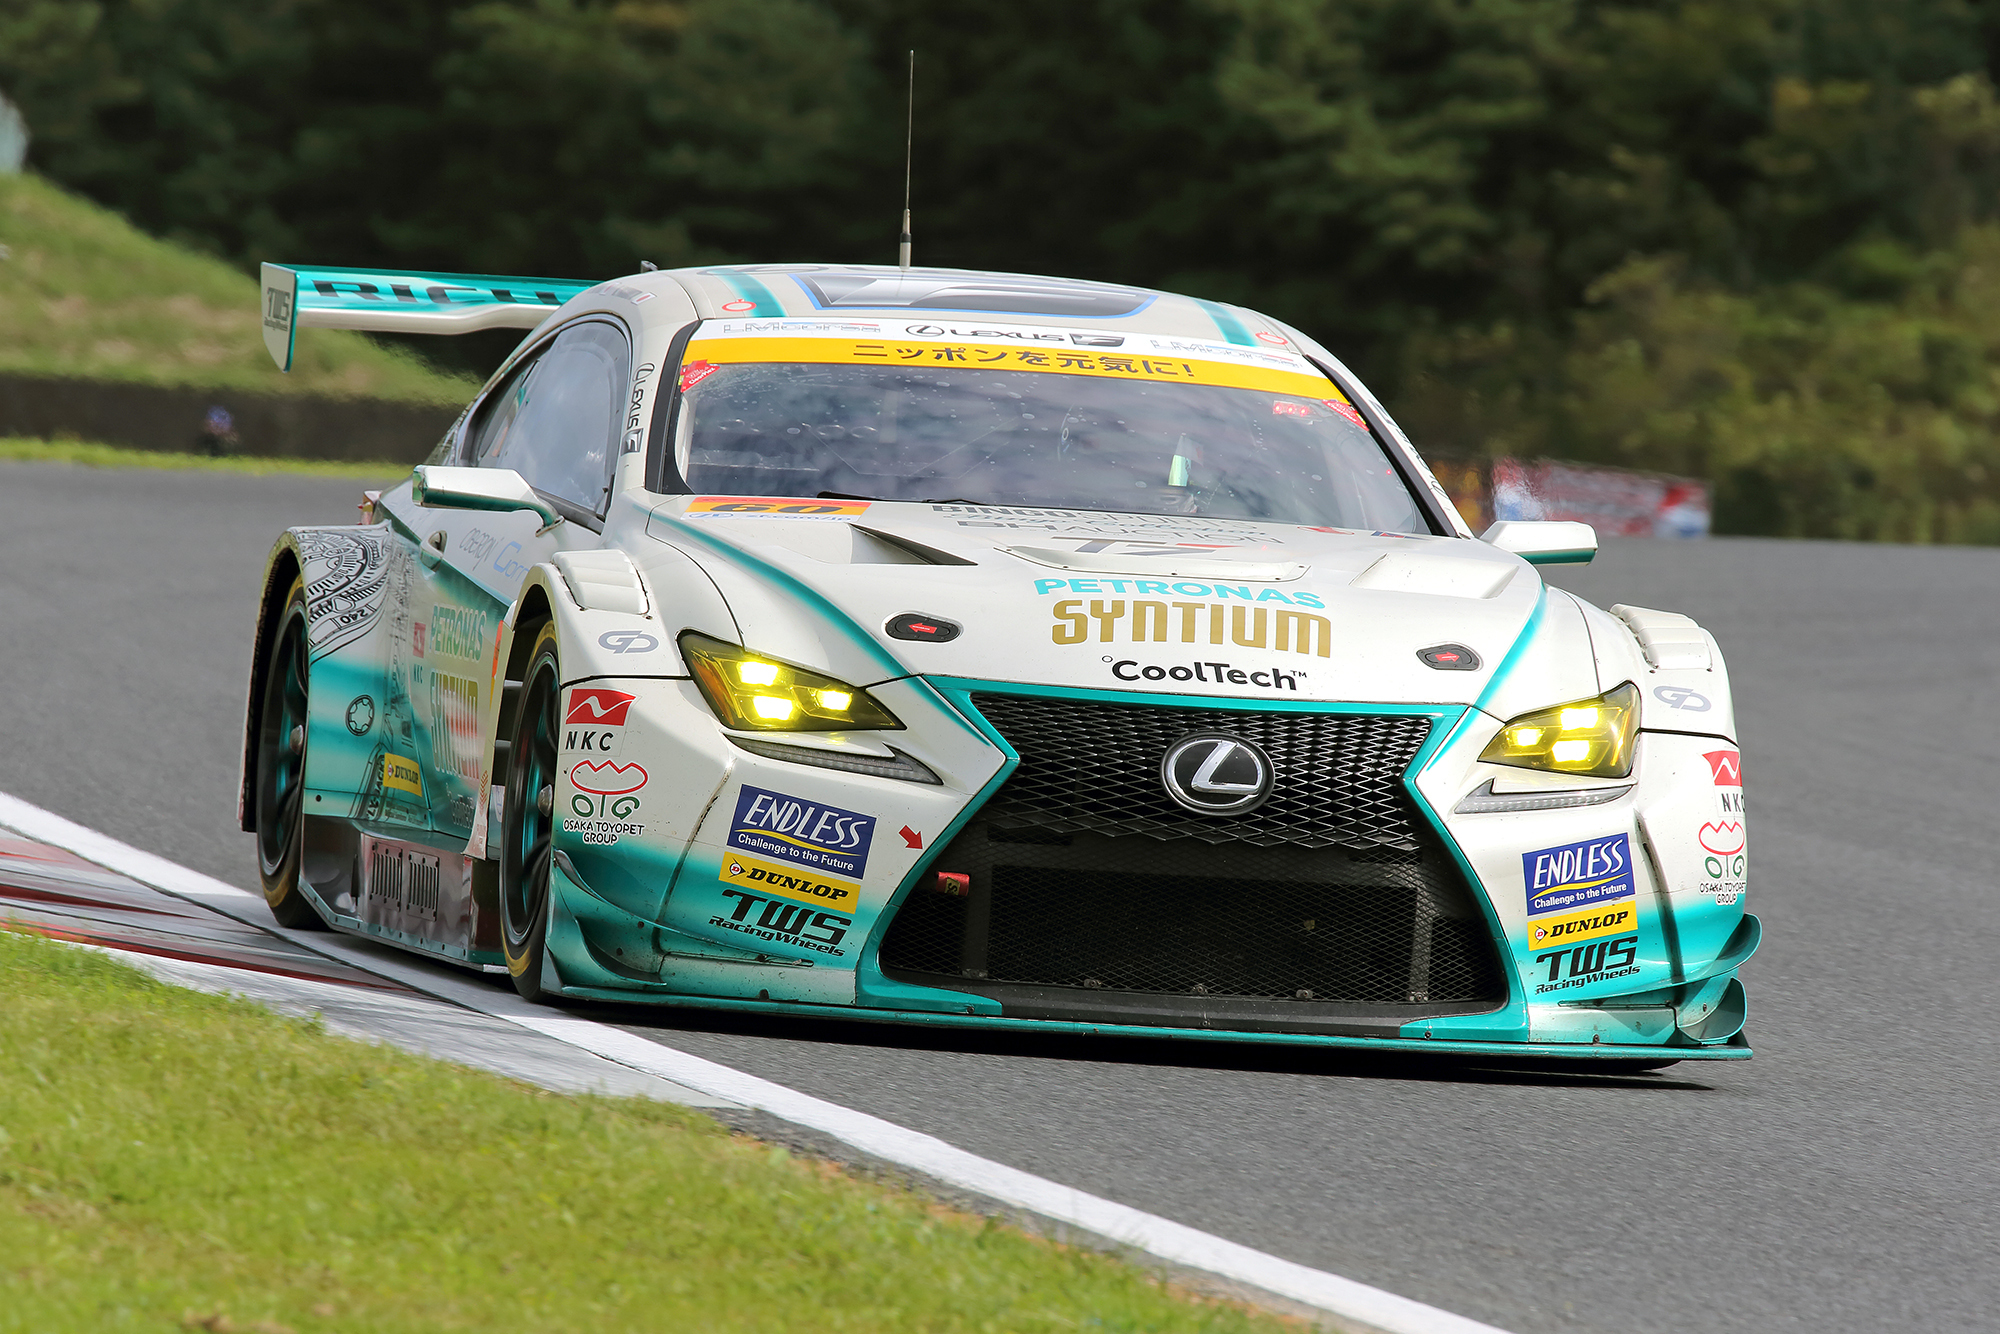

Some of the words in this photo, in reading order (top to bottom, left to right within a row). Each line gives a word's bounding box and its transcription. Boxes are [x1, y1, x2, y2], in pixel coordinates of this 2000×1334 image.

[950, 328, 1065, 342] LEXUS
[627, 380, 646, 431] LEXUS
[710, 503, 843, 514] 60
[1033, 578, 1326, 609] PETRONAS
[429, 603, 487, 663] PETRONAS
[1051, 599, 1331, 658] SYNTIUM
[565, 730, 614, 752] NKC
[563, 819, 594, 833] OSAKA
[596, 820, 646, 836] TOYOPET
[742, 793, 868, 849] ENDLESS
[583, 832, 619, 845] GROUP
[737, 833, 787, 855] Challenge
[789, 846, 800, 858] to
[802, 849, 819, 862] the
[821, 853, 854, 871] Future
[1532, 838, 1625, 890] ENDLESS
[746, 866, 849, 901] DUNLOP
[1534, 890, 1575, 910] Challenge
[1576, 892, 1585, 902] to
[1586, 887, 1600, 900] the
[1602, 882, 1627, 897] Future
[1699, 882, 1724, 893] OSAKA
[1716, 892, 1737, 905] GROUP
[721, 888, 853, 947] TWS
[1550, 911, 1629, 939] DUNLOP
[1536, 935, 1639, 982] TWS
